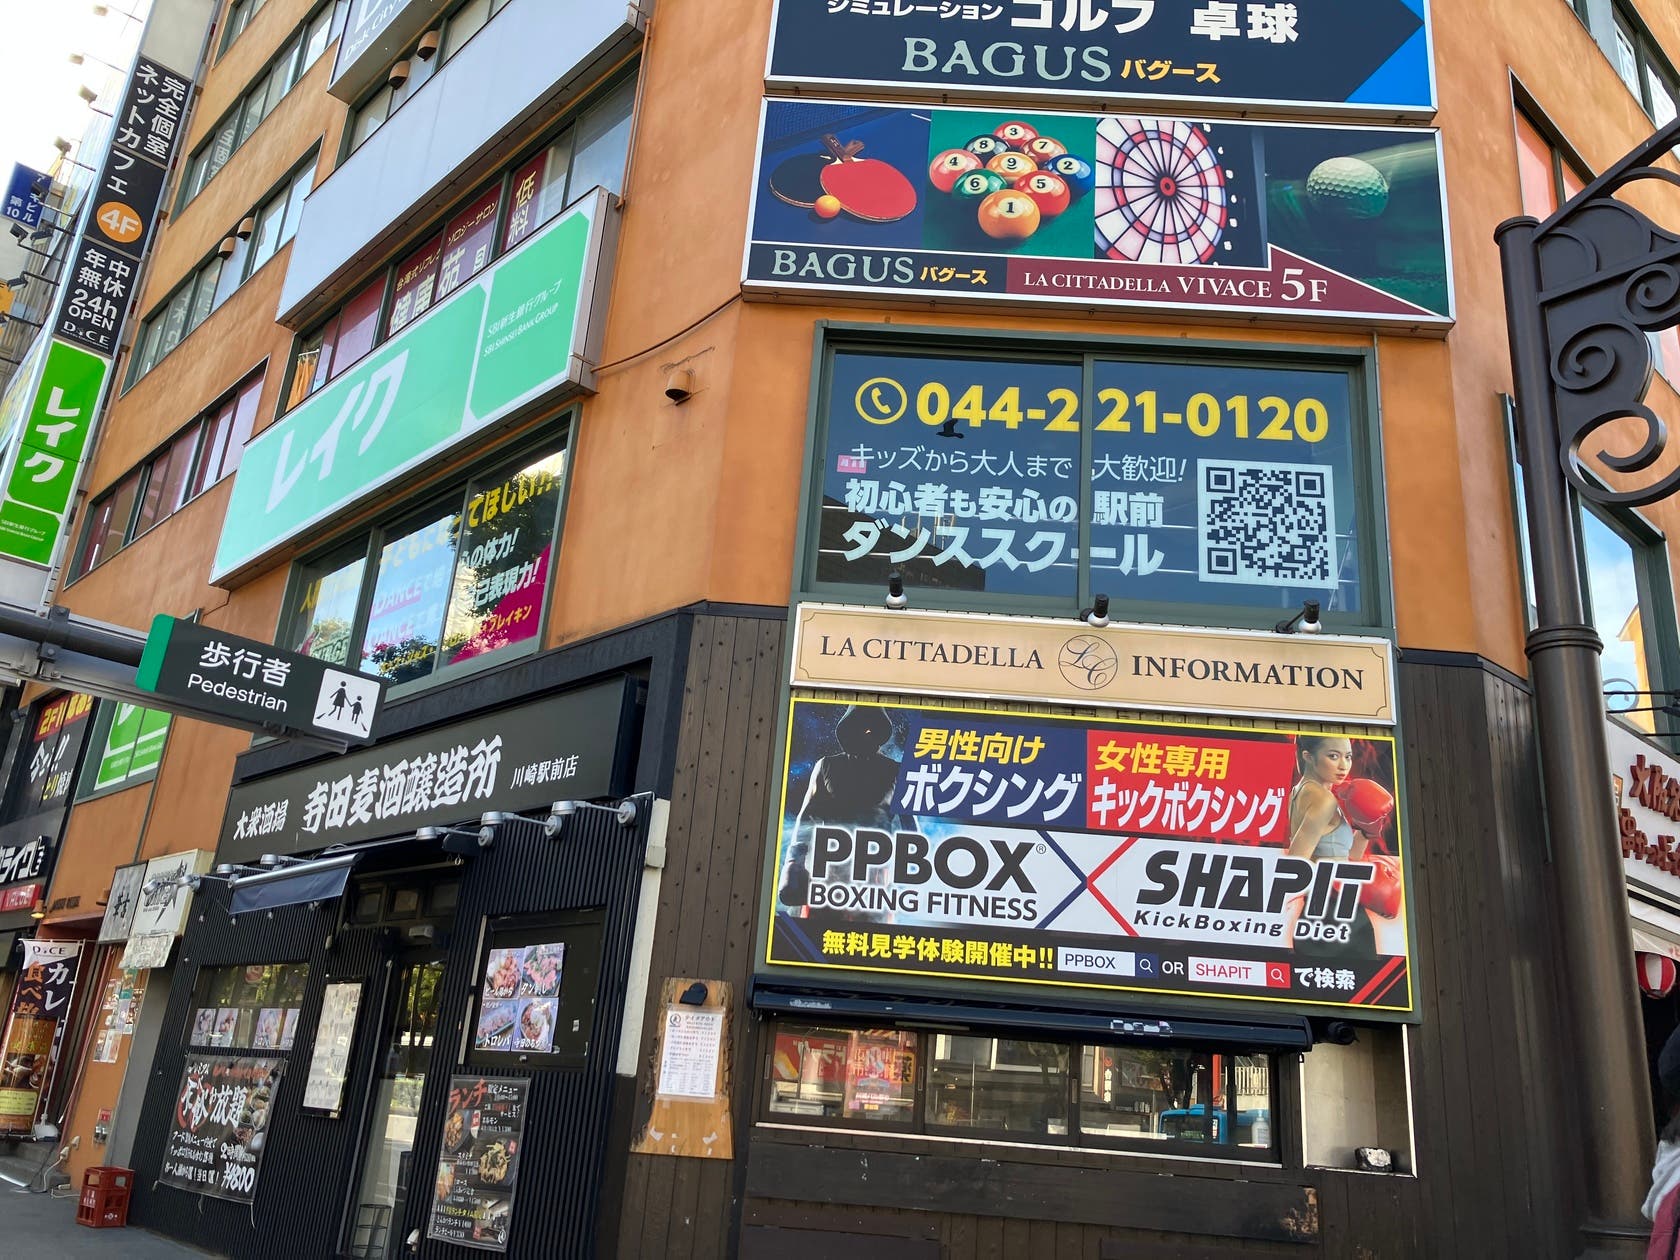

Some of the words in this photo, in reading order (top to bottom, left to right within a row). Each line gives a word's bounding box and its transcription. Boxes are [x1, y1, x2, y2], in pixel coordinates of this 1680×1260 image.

[1190, 1, 1299, 44] 卓球
[902, 37, 1111, 82] BAGUS
[1120, 59, 1222, 84] バグース
[106, 63, 160, 196] ネットカフェ
[143, 75, 187, 160] 完全個室
[1010, 127, 1018, 136] 3
[949, 156, 958, 166] 4
[1007, 157, 1017, 167] 9
[1063, 161, 1073, 170] 2
[979, 140, 988, 149] 8
[1039, 141, 1048, 150] 7
[970, 177, 980, 188] 6
[1037, 179, 1046, 189] 5
[100, 208, 139, 236] 4F
[1006, 202, 1015, 213] 1
[772, 249, 914, 285] BAGUS
[920, 266, 989, 285] バグース
[1024, 271, 1050, 287] LA
[1052, 273, 1171, 293] CITTADELLA
[1177, 275, 1271, 299] VIVACE
[1280, 268, 1328, 302] 5F
[58, 304, 114, 332] OPEN
[71, 288, 118, 320] 24h
[24, 386, 80, 483] レイク
[265, 349, 410, 514] レイク
[842, 517, 1165, 577] ダンススクール
[199, 640, 292, 688] 歩行者
[820, 635, 858, 659] LA
[862, 637, 1044, 671] CITTADELLA
[1132, 655, 1365, 690] INFORMATION
[187, 673, 288, 713] Pedestrian
[914, 728, 1045, 765] 男性向け
[1096, 739, 1231, 780] 女性専用
[233, 799, 289, 840] 大衆酒場
[301, 734, 503, 833] 寺田麦酒醸造所
[510, 754, 580, 790] 川崎駅前店
[901, 764, 1083, 823] ボクシング
[1091, 782, 1286, 839] キックボクシング
[811, 827, 1039, 894] PPBOX
[1136, 850, 1373, 921] SHAPIT
[809, 883, 920, 914] BOXING
[926, 892, 1038, 923] FITNESS
[1133, 911, 1283, 938] KickBoxing
[1293, 923, 1350, 942] Diet
[822, 929, 1054, 971] 無料見学体験開催中!!
[1064, 954, 1116, 971] PPBOX
[1162, 961, 1184, 976] OR
[1195, 963, 1252, 980] SHAPIT
[1294, 966, 1355, 992] で検索
